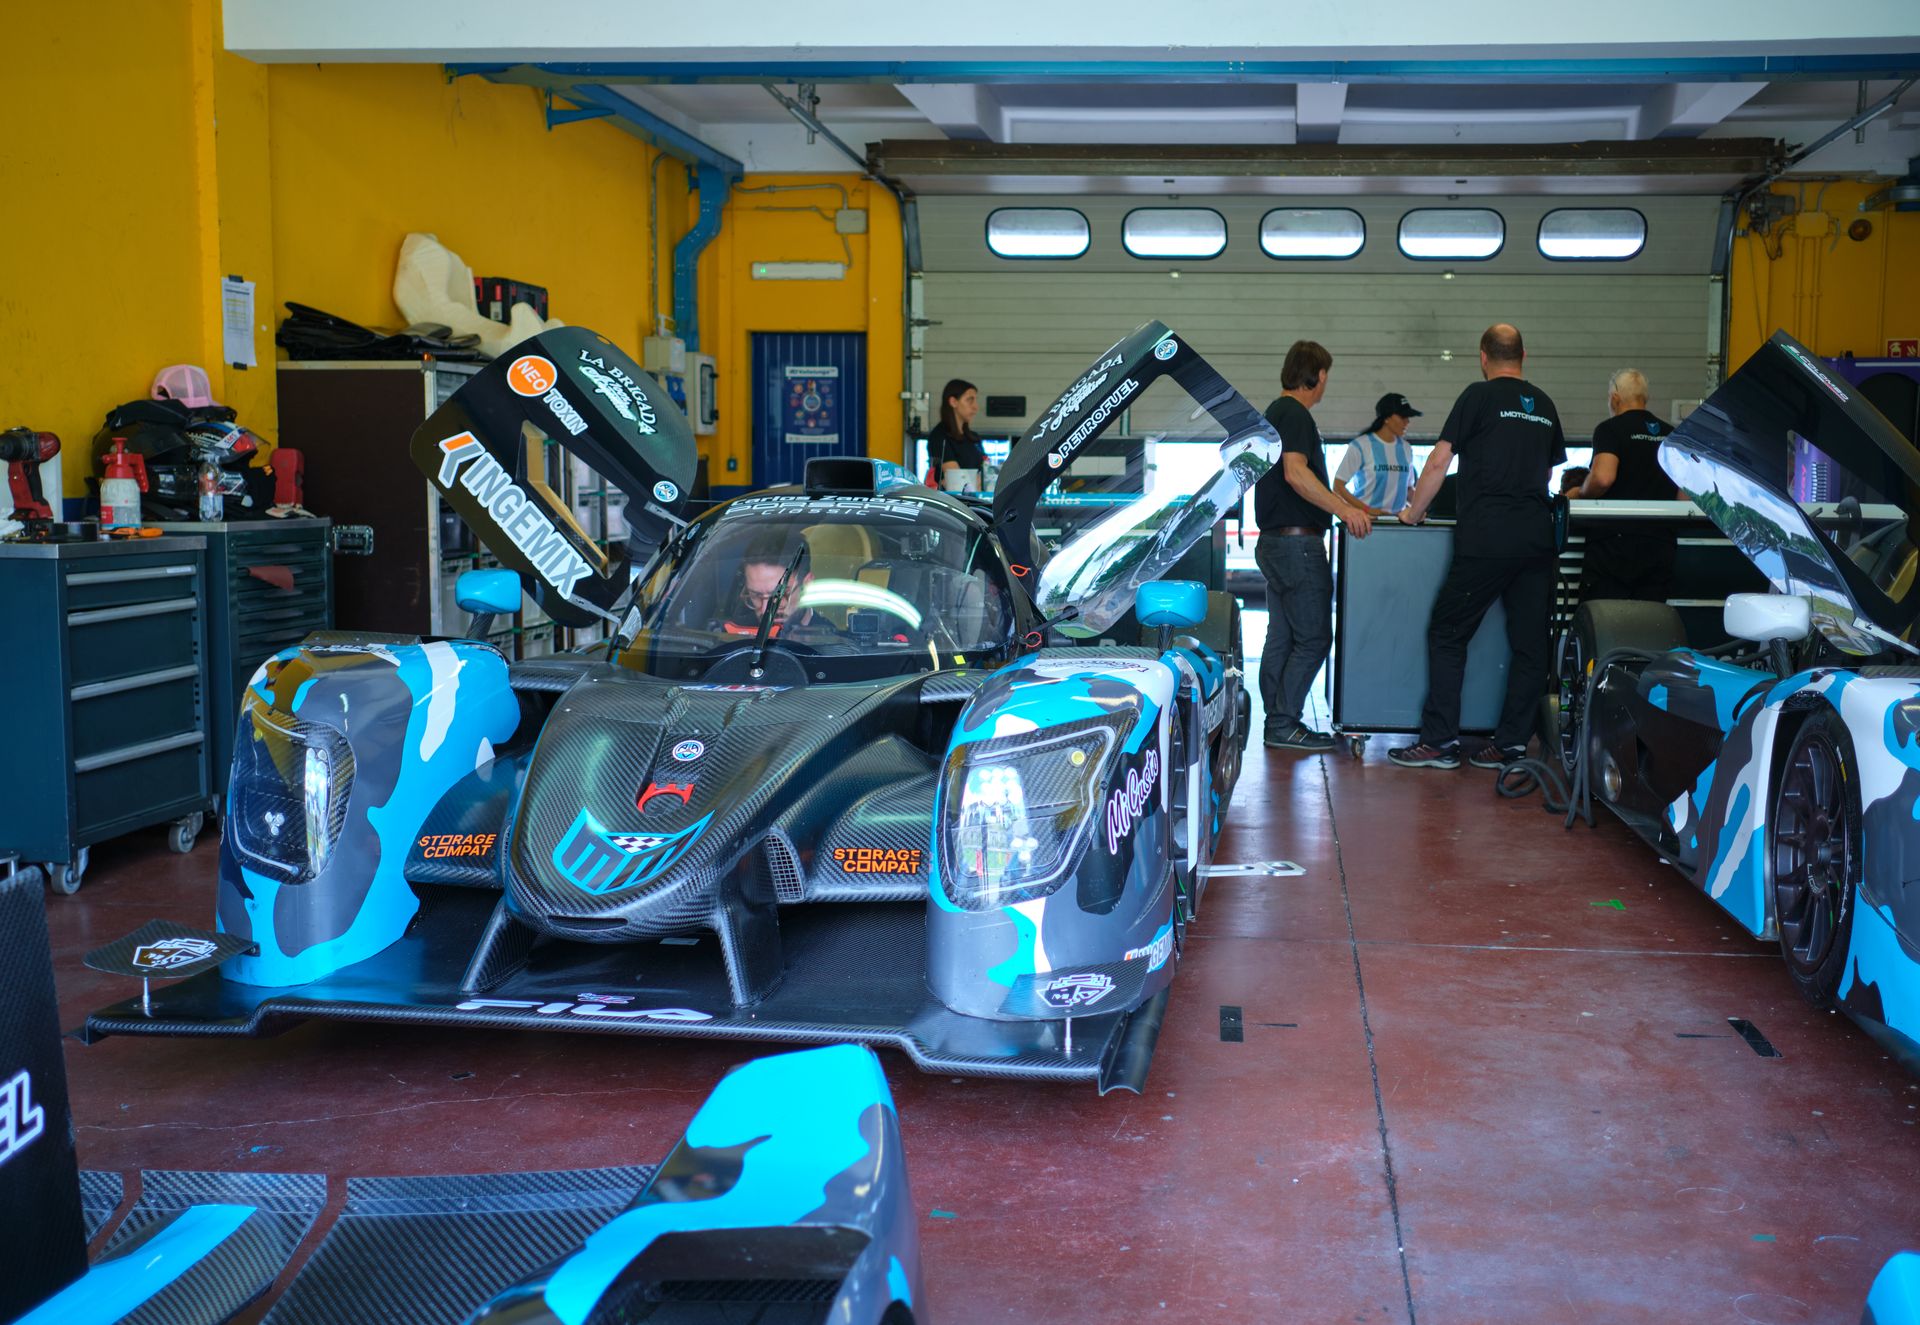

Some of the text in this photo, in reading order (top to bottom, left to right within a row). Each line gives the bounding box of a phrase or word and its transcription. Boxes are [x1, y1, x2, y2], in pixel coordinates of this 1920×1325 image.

[516, 360, 548, 392] NEO
[580, 349, 657, 435] LA BRIGADA
[543, 388, 588, 435] TOXIN
[1058, 378, 1140, 458] PETROFUEL
[724, 500, 920, 516] PORSCHE
[460, 452, 593, 599] INGEMIX
[420, 834, 496, 847] STORAGE
[423, 845, 492, 859] COMPAT
[834, 848, 921, 861] STORAGE
[843, 860, 920, 873] COMPAT
[456, 999, 713, 1021] FILA
